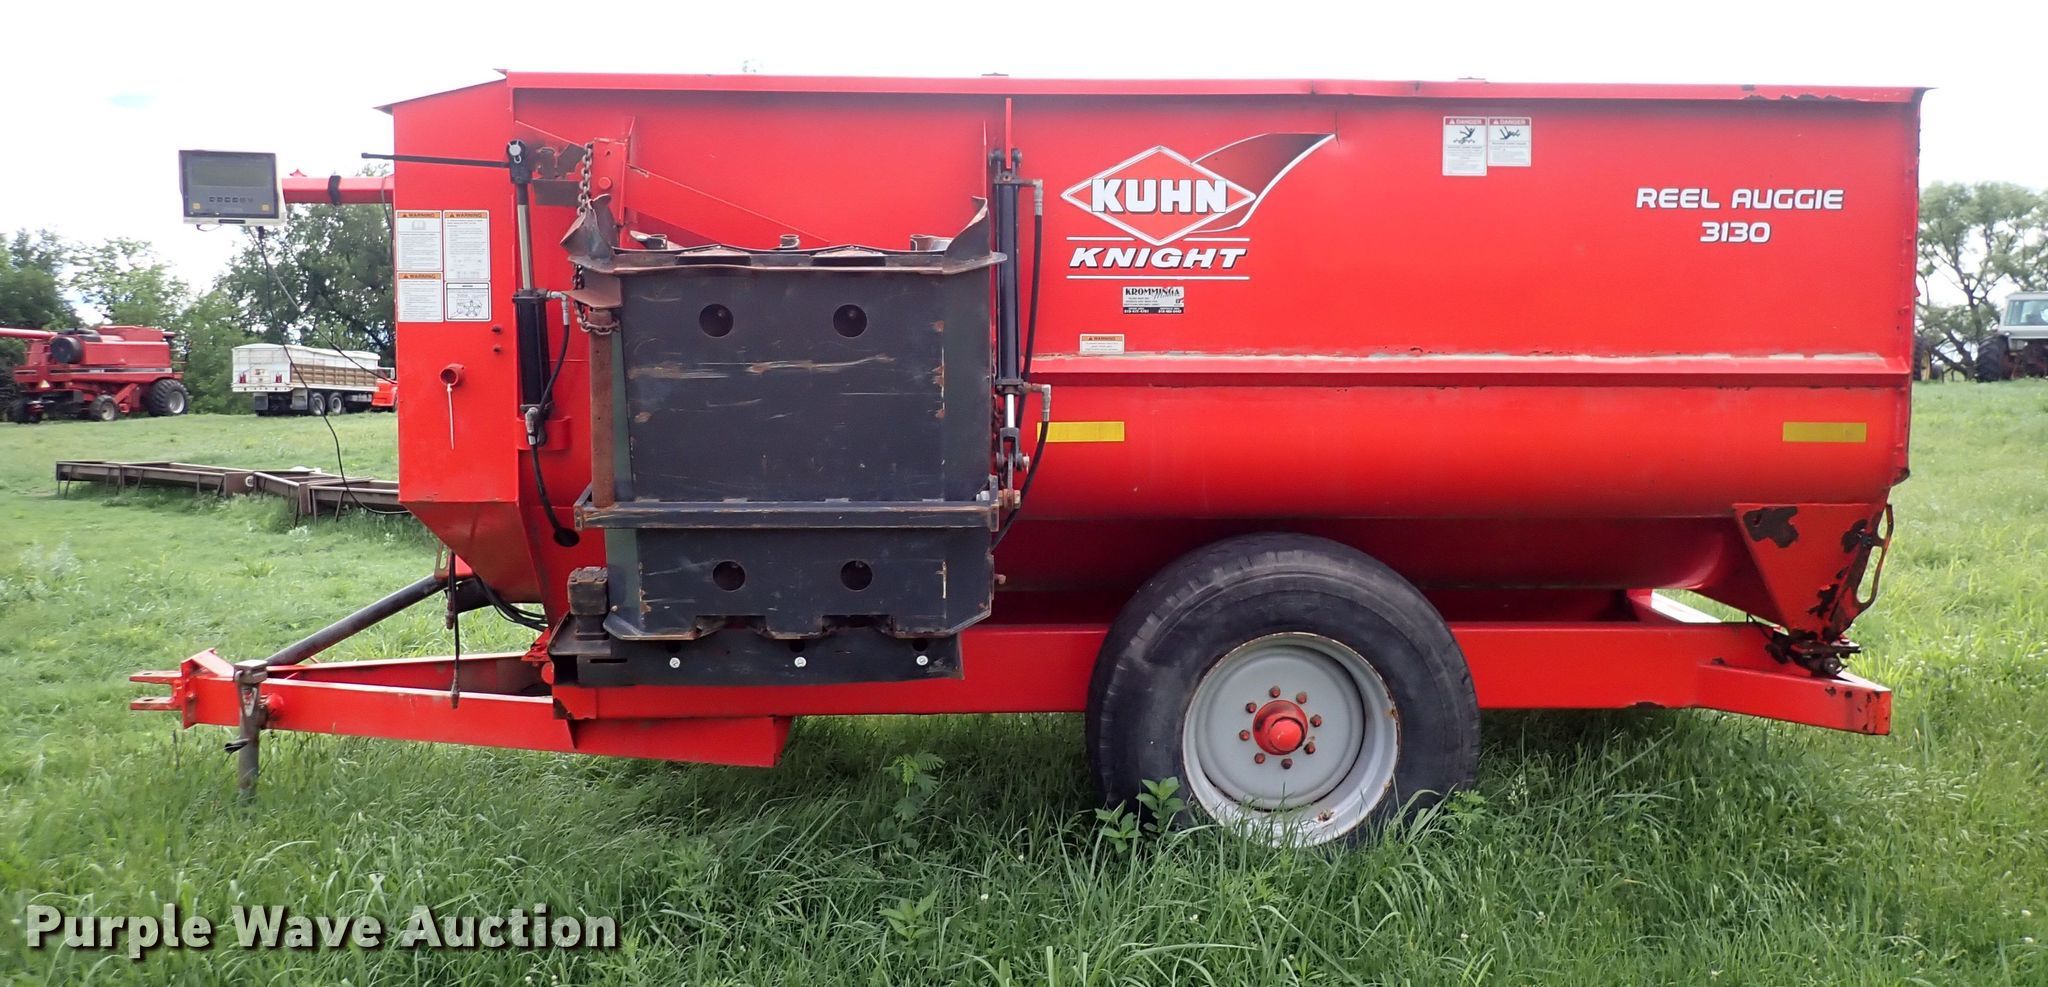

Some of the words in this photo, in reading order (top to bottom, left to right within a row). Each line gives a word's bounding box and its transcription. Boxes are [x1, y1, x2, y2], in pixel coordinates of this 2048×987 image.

[1091, 179, 1227, 213] KUHN
[1636, 188, 1720, 209] REEL
[1731, 189, 1844, 210] AUGGIE
[1700, 222, 1771, 243] 3130
[1069, 247, 1247, 269] KNIGHT
[1125, 287, 1180, 296] KROMMINGA
